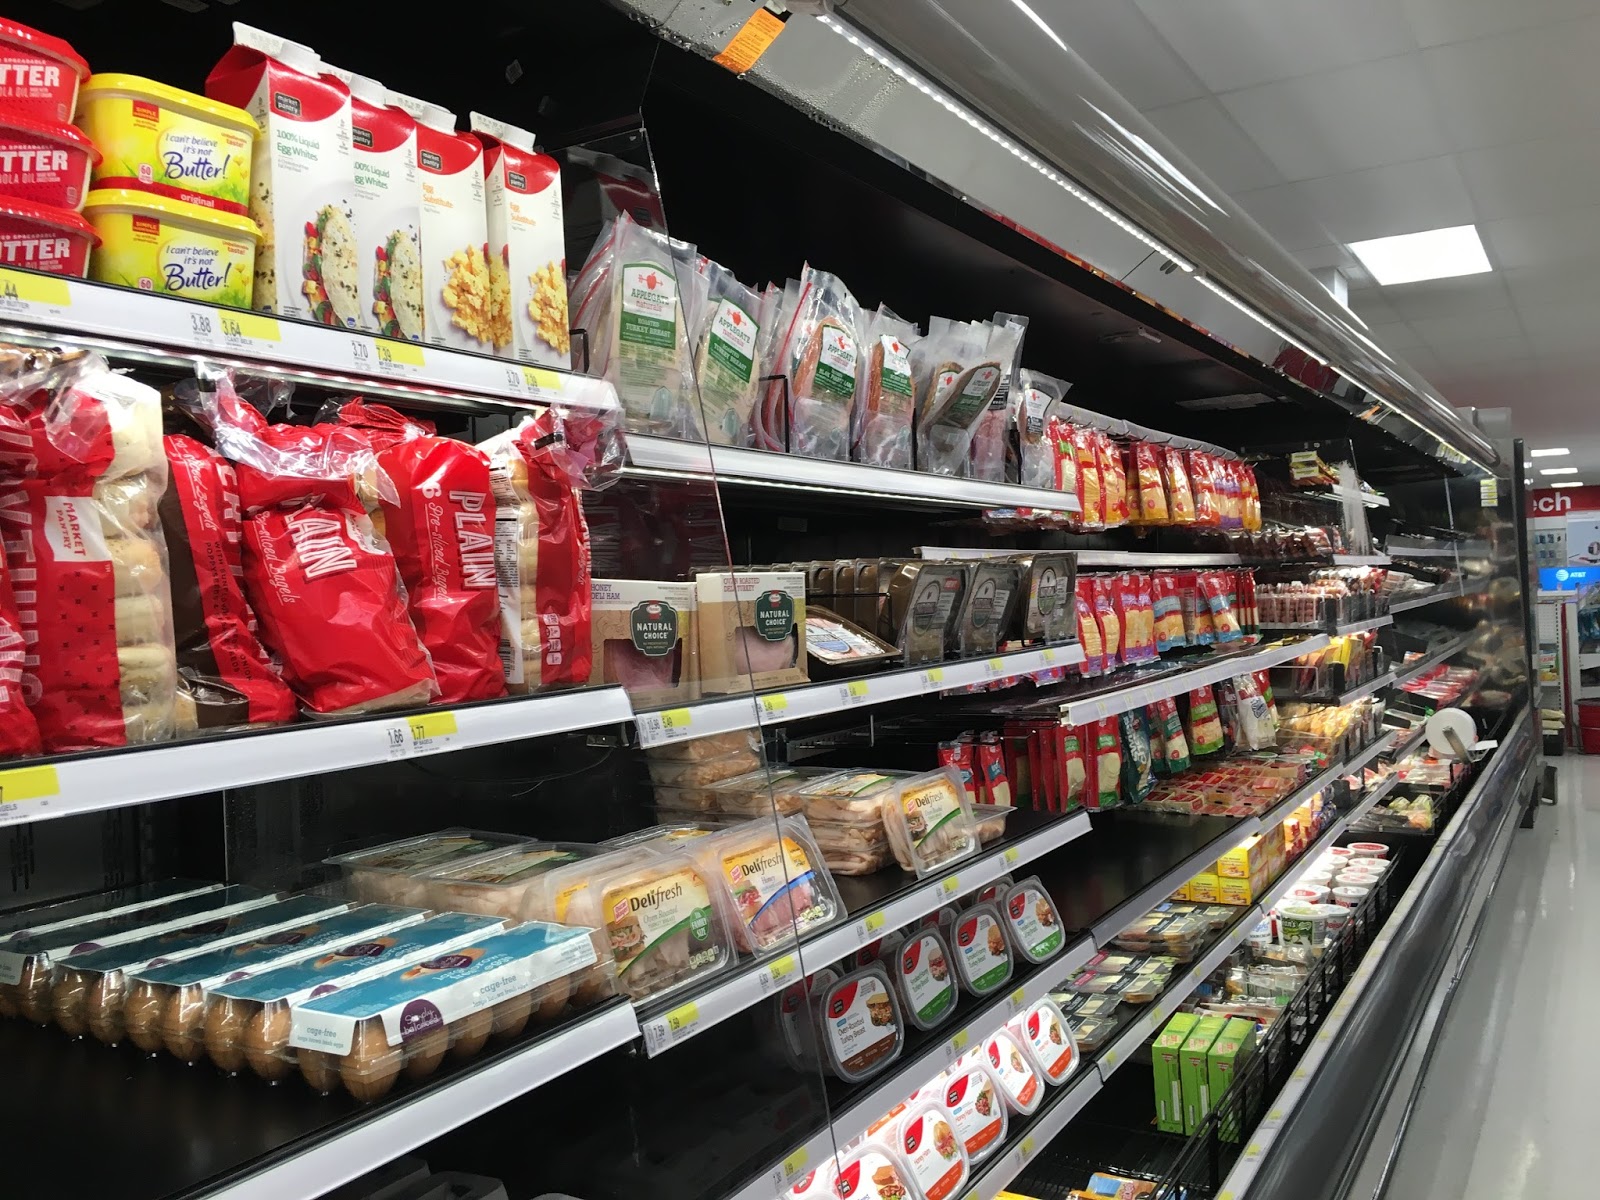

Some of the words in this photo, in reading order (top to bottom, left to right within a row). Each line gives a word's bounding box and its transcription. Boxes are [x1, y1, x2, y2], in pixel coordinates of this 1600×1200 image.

[278, 95, 298, 106] market
[278, 102, 298, 114] pantry
[170, 134, 190, 144] can't
[192, 136, 218, 148] believe
[276, 130, 298, 143] 100%
[298, 134, 320, 150] Liquid
[183, 145, 196, 154] it's
[198, 148, 212, 156] not
[276, 142, 292, 156] Egg
[292, 146, 318, 162] Whites
[422, 153, 440, 162] market
[163, 152, 230, 180] Butter!
[354, 162, 370, 172] 00%
[370, 166, 390, 178] Liquid
[423, 160, 440, 168] pantry
[354, 175, 364, 185] gg
[364, 177, 388, 189] Whites
[180, 193, 215, 208] original
[423, 194, 454, 208] Substitute
[510, 213, 536, 226] Substitute
[0, 238, 70, 261] TTER
[170, 247, 191, 256] can't
[192, 248, 219, 256] believe
[184, 256, 197, 264] it's
[198, 258, 214, 266] not
[164, 262, 232, 291] Butter!
[631, 288, 670, 305] APPLEGATE
[191, 314, 212, 333] 3.88
[222, 320, 242, 337] 3.64
[718, 317, 750, 344] APPLEGATE
[352, 342, 368, 358] 3.70
[1533, 492, 1572, 512] ch
[56, 509, 72, 550] PANTRY
[63, 502, 86, 556] MARKET
[428, 502, 446, 566] Pre-sliced
[284, 505, 358, 579] LAIN
[449, 490, 497, 590] PLAIN
[270, 563, 301, 604] Bagels
[430, 566, 448, 601] Bagels
[606, 592, 620, 600] HAM
[760, 610, 790, 619] NATURAL
[765, 618, 786, 626] CHOICE
[636, 622, 672, 631] NATURAL
[644, 632, 667, 640] CHOICE
[388, 729, 404, 744] 1.66
[411, 726, 425, 740] 1.77
[761, 876, 776, 884] Honey
[658, 906, 678, 918] Roasted
[480, 974, 517, 994] cage-free
[306, 1026, 336, 1038] cage-free
[838, 1018, 865, 1036] Oven-Roasted
[840, 1033, 854, 1044] Turkey
[854, 1026, 866, 1038] Breast
